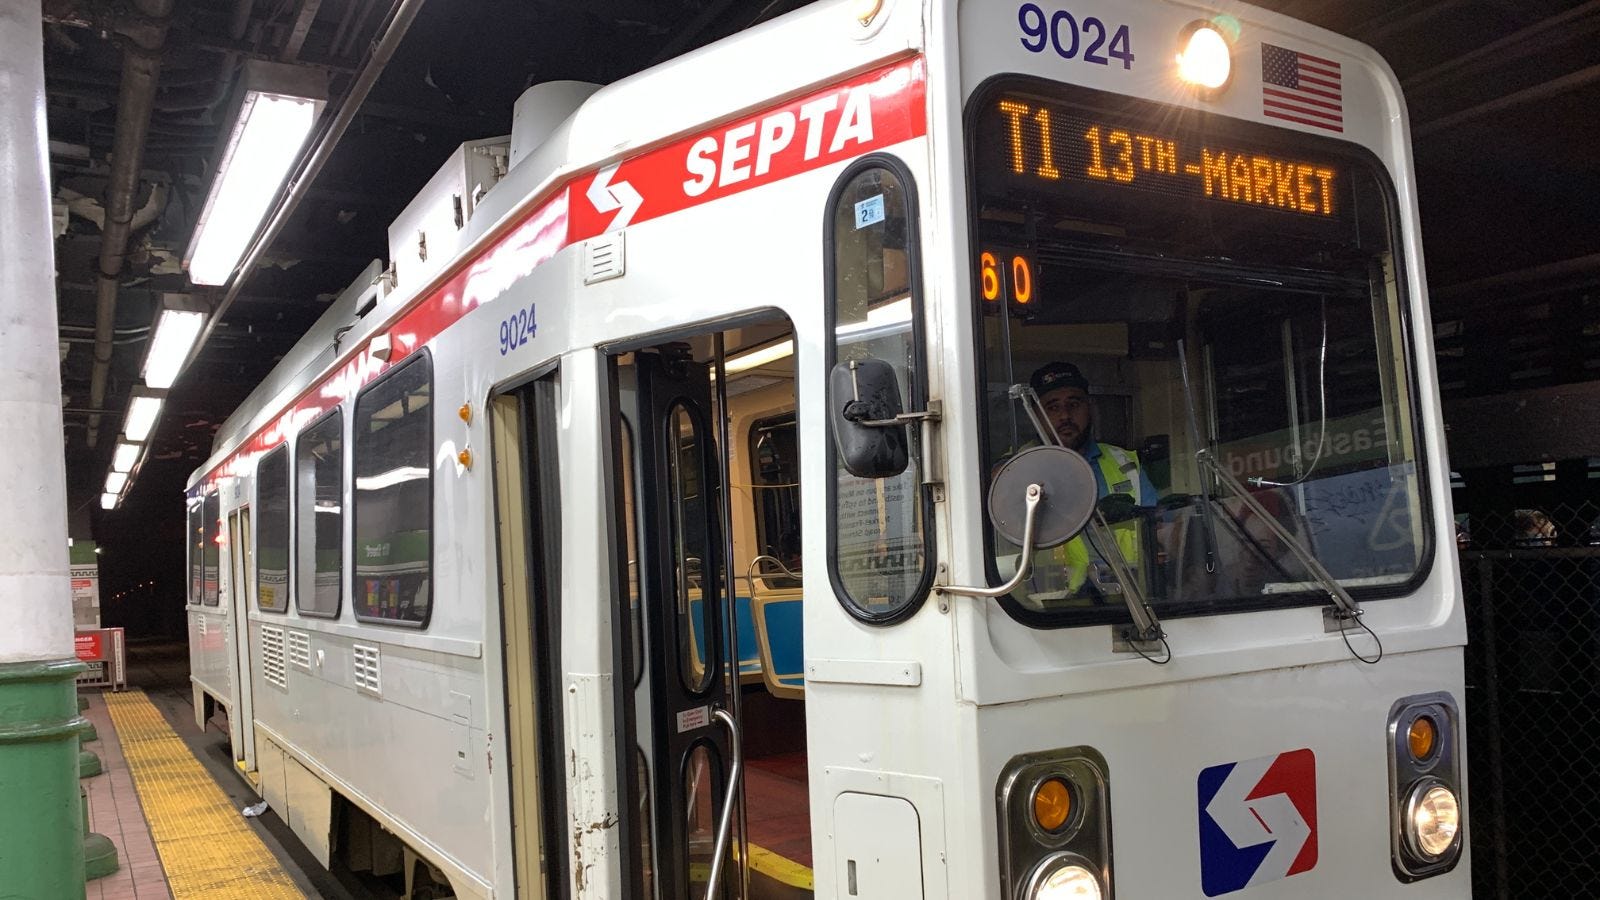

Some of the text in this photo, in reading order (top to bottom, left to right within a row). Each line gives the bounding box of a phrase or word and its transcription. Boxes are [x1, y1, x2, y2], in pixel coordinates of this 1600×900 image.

[1018, 3, 1135, 70] 9024
[683, 83, 874, 197] SEPTA
[1000, 100, 1059, 179] T1
[500, 302, 537, 356] 9024
